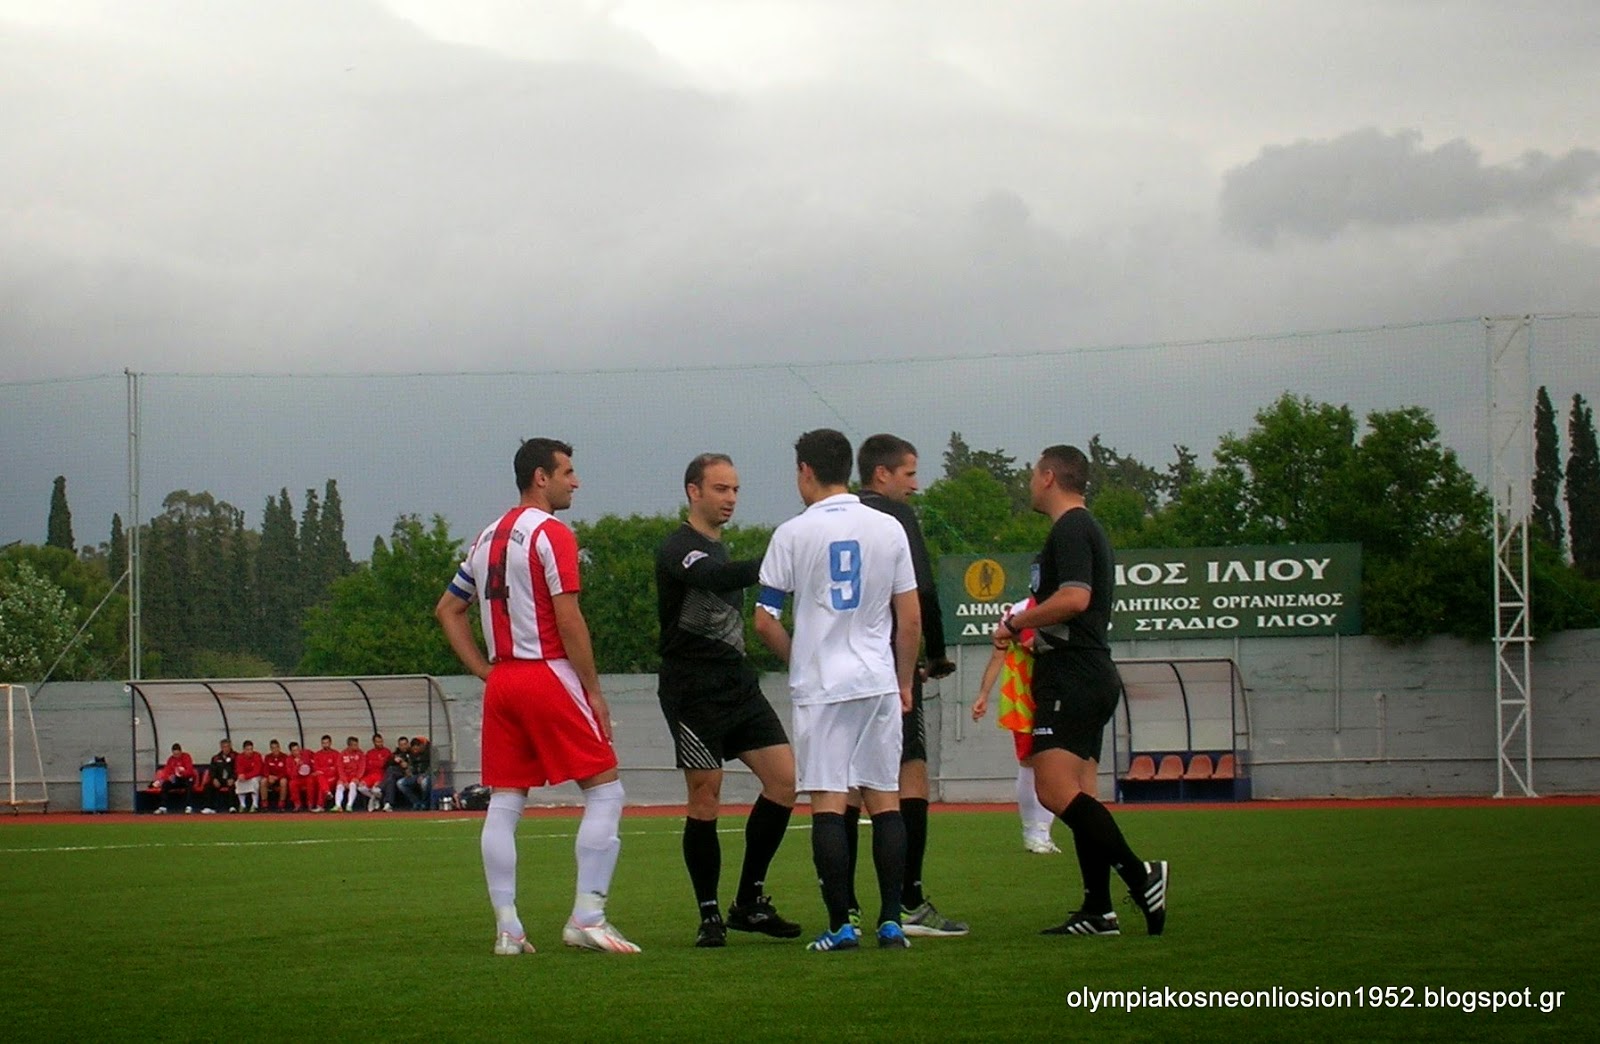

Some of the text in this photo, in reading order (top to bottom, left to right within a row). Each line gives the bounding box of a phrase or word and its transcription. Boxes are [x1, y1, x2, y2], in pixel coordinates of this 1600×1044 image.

[485, 546, 510, 616] 4
[829, 539, 862, 611] 9
[1207, 558, 1331, 583] ΙΛΙΟΥ
[1111, 596, 1201, 612] ΛΗΤΙΚΟΣ
[1212, 593, 1344, 609] ΟΡΓΑΝΙΣΜΟΣ
[1134, 615, 1239, 631] ΣΤΑΔΙΟ
[1256, 613, 1337, 628] ΙΛΙΟΥ
